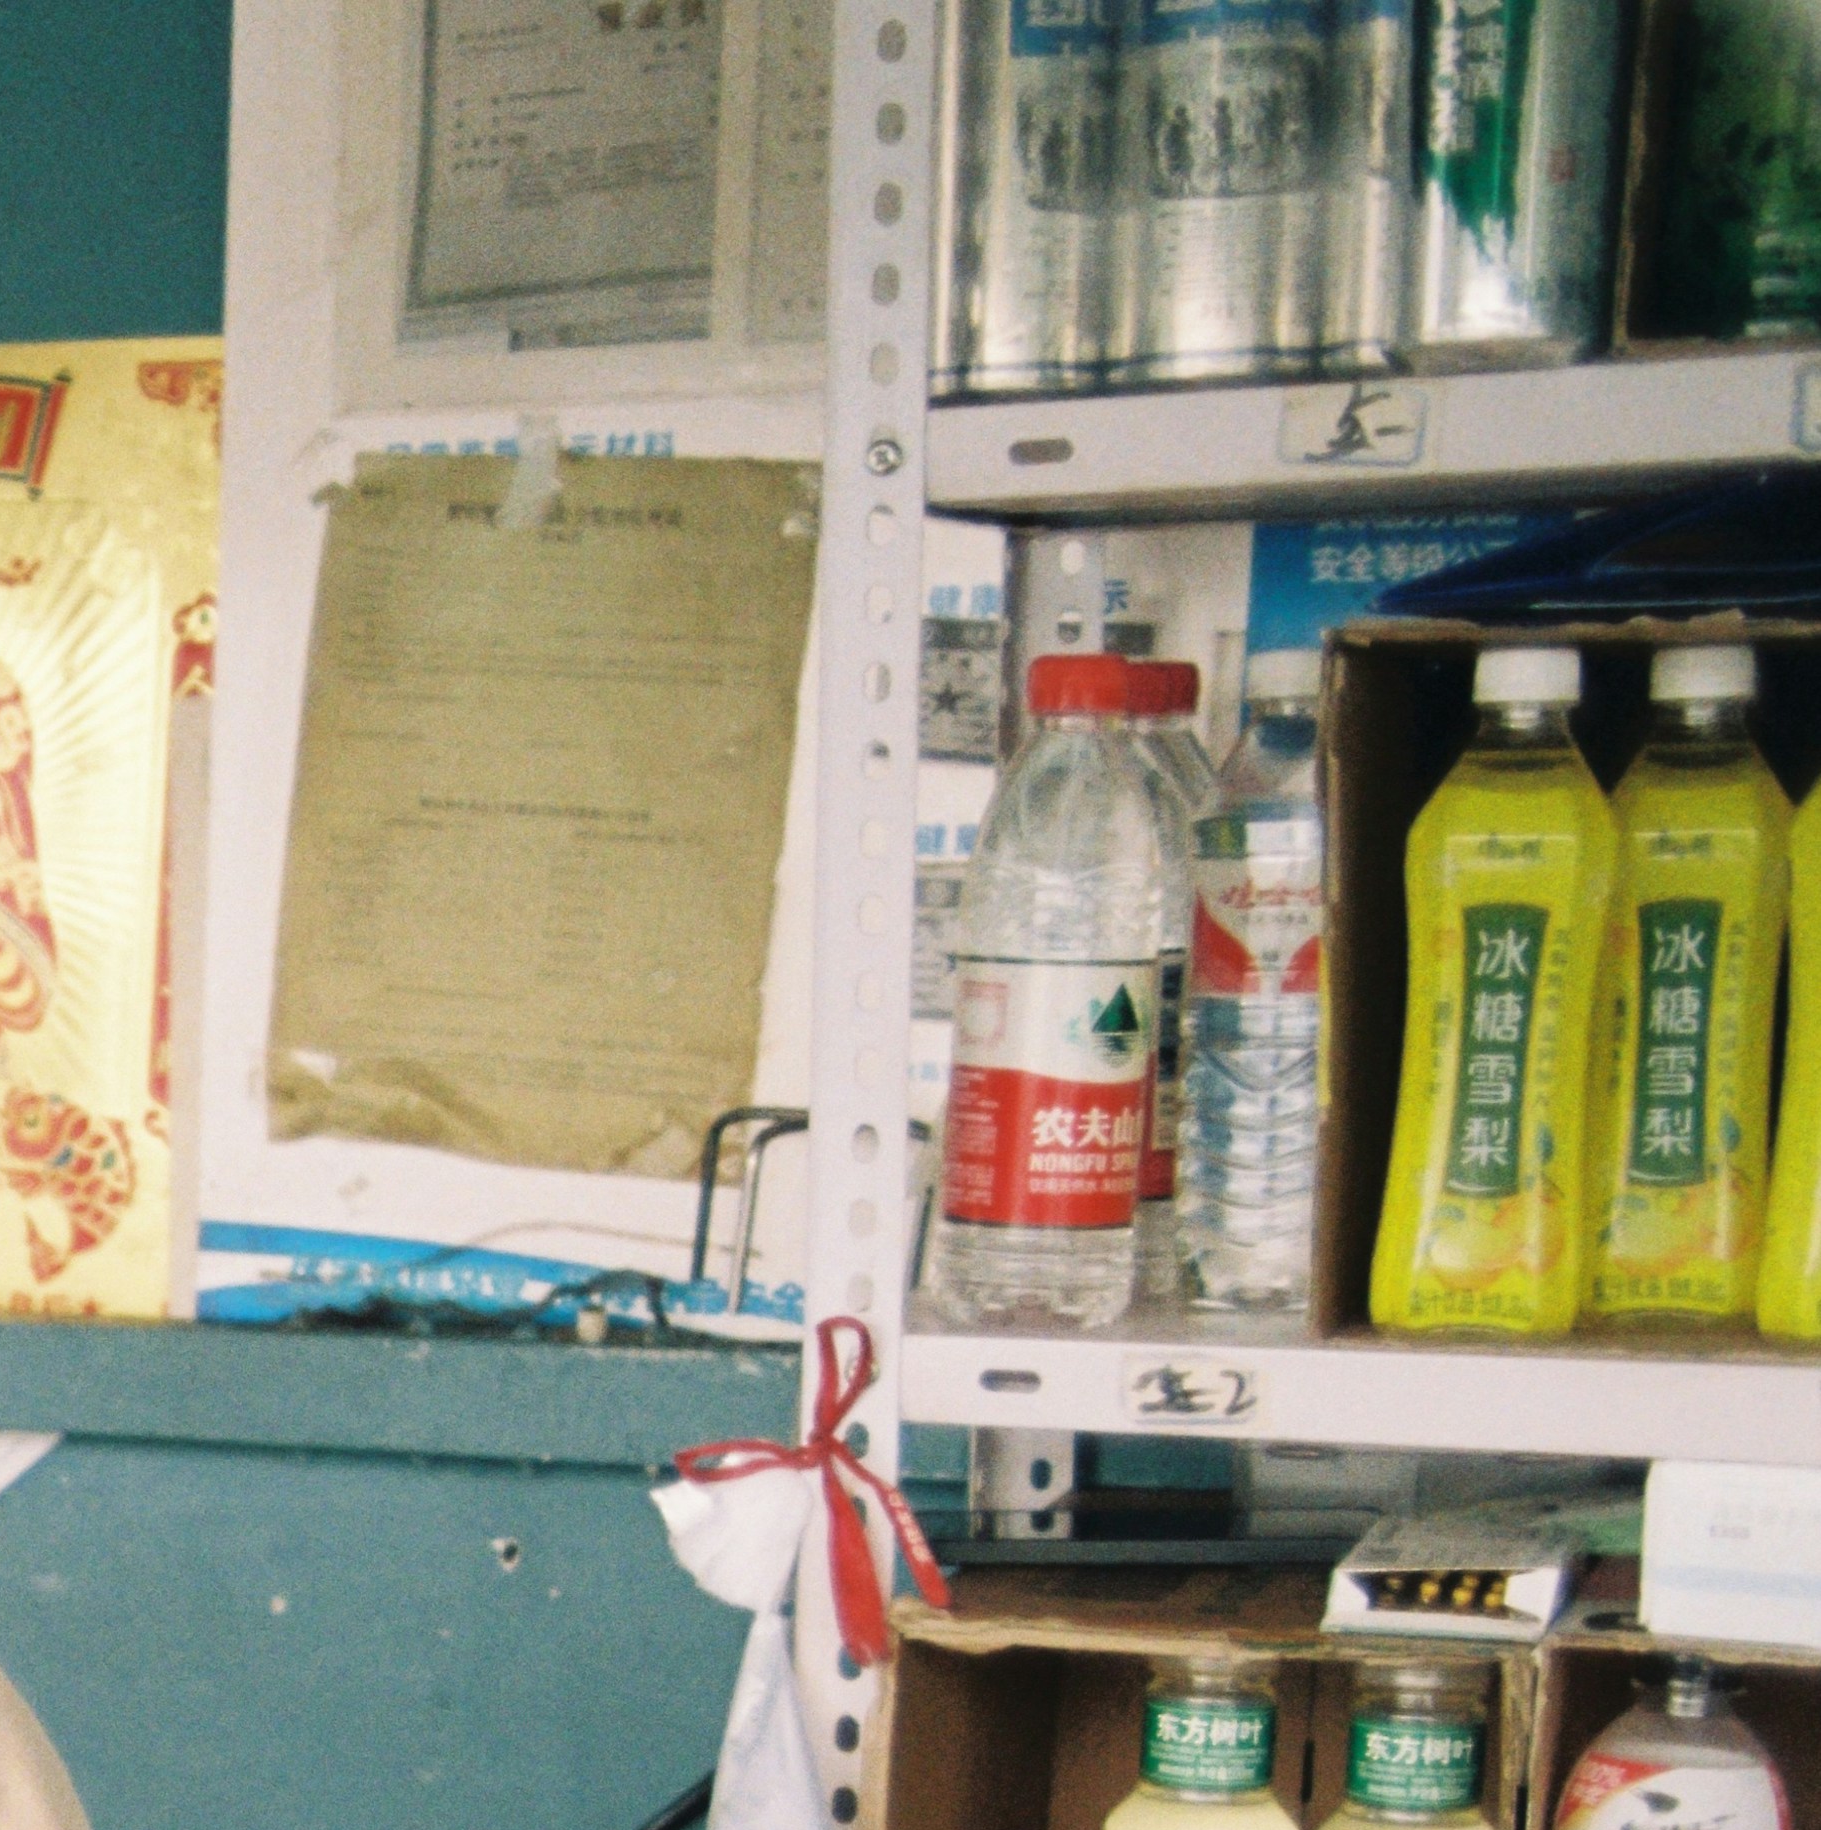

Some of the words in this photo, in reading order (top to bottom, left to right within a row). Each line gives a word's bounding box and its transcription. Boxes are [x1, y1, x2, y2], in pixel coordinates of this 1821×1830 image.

[1461, 929, 1530, 1166] 冰糖雪梨
[1642, 924, 1707, 1155] 冰糖雪梨
[1028, 1152, 1108, 1172] NONGFU
[1157, 1712, 1263, 1746] 东方树叶
[1365, 1732, 1473, 1766] 东方树叶
